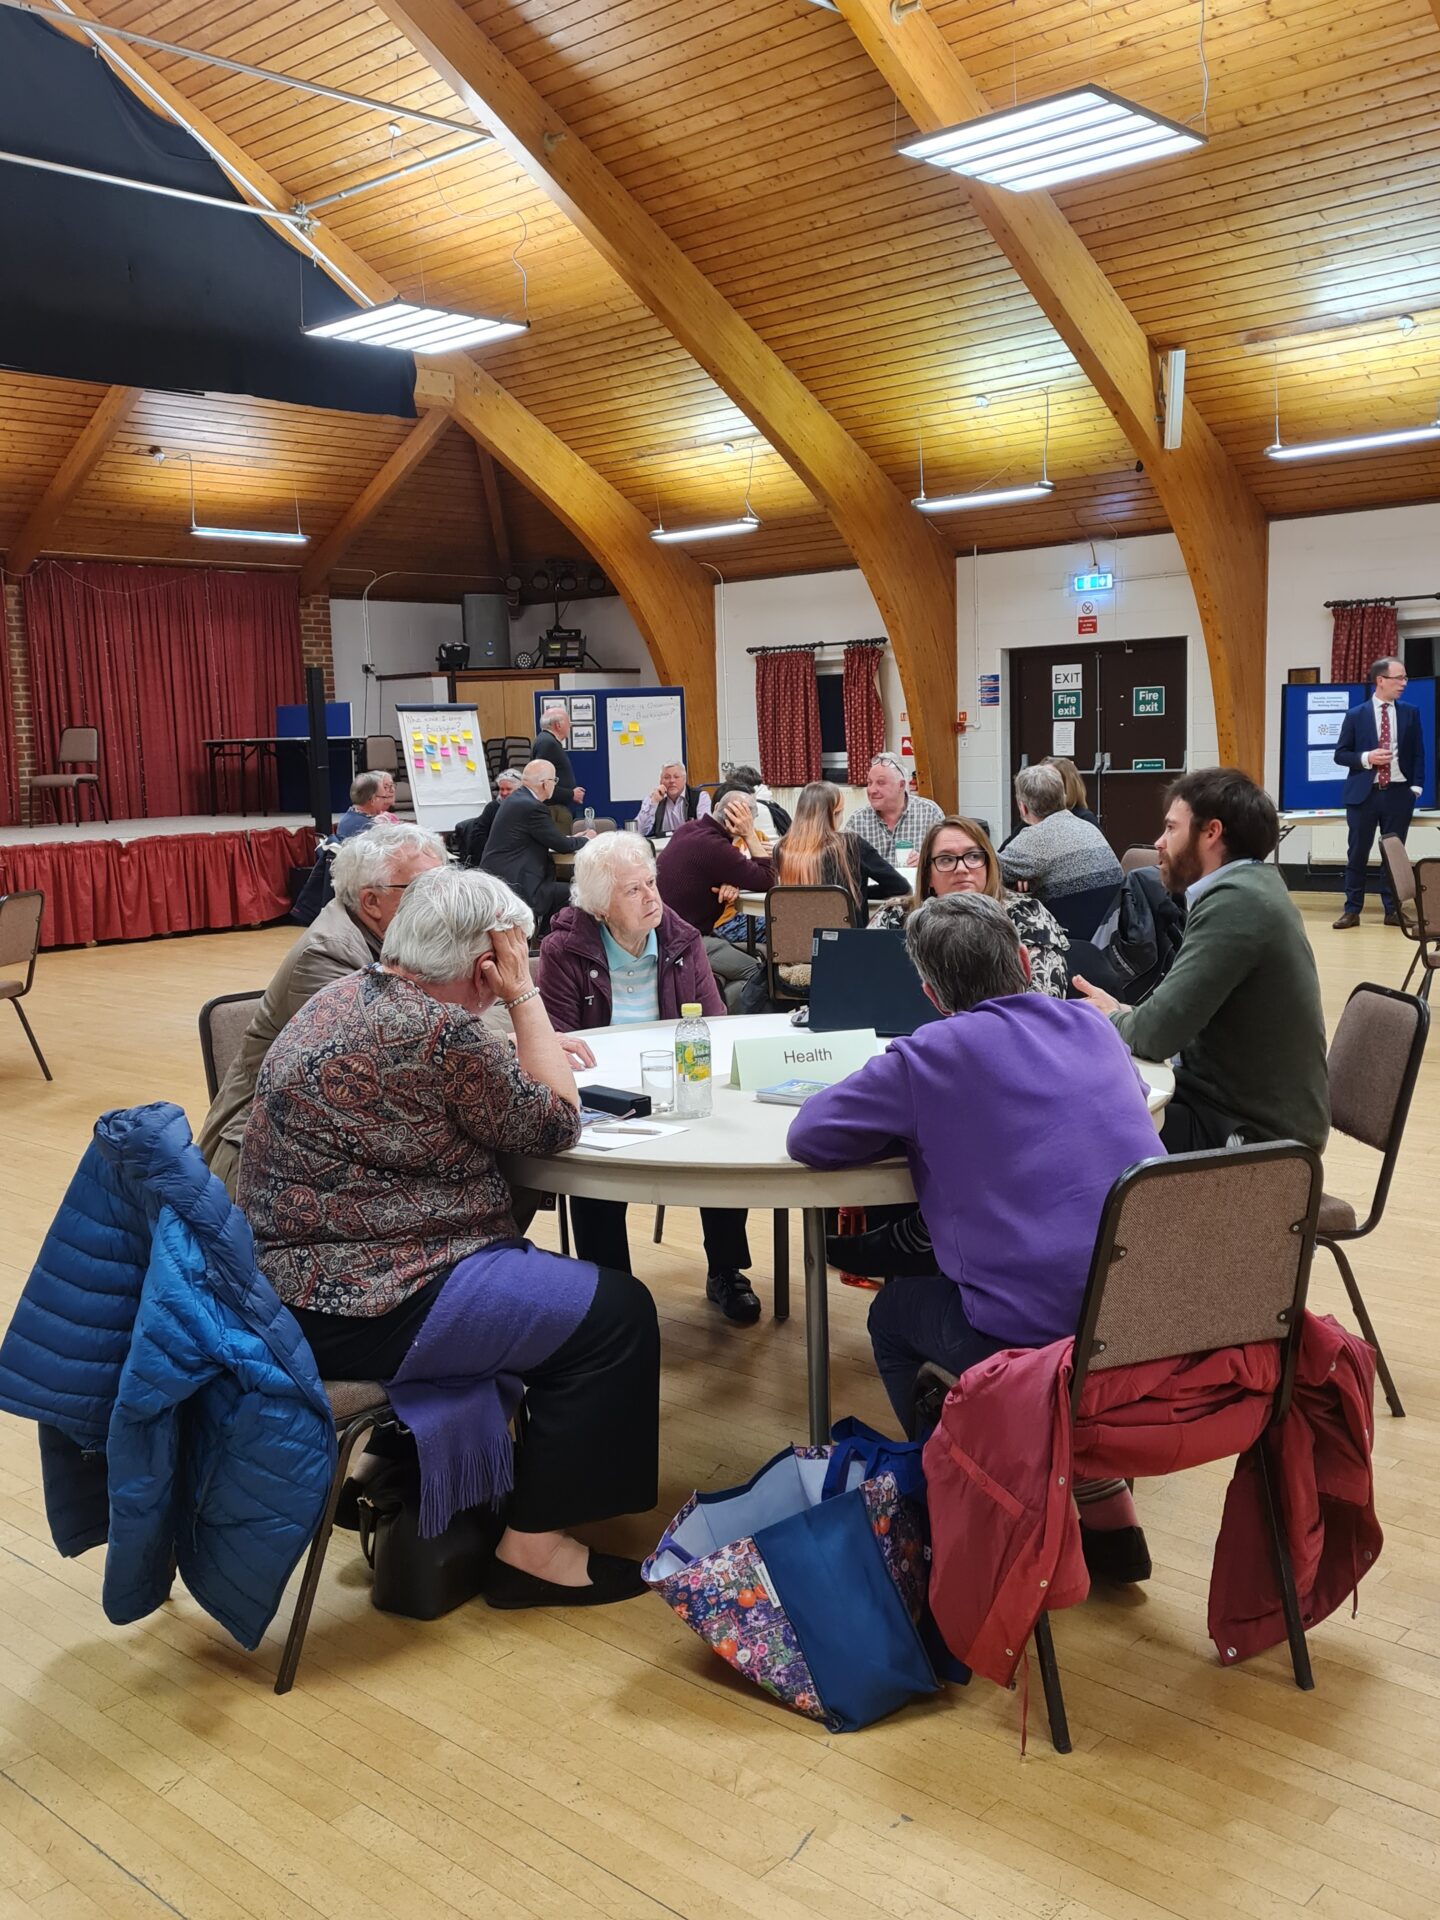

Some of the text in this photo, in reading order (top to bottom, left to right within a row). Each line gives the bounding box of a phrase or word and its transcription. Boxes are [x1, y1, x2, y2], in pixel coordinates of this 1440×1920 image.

[1055, 672, 1081, 684] EXIT
[1058, 694, 1077, 705] Fire
[1139, 690, 1159, 701] Fire
[1058, 705, 1077, 715] exit
[1139, 701, 1159, 712] exit
[784, 1047, 832, 1064] Health
